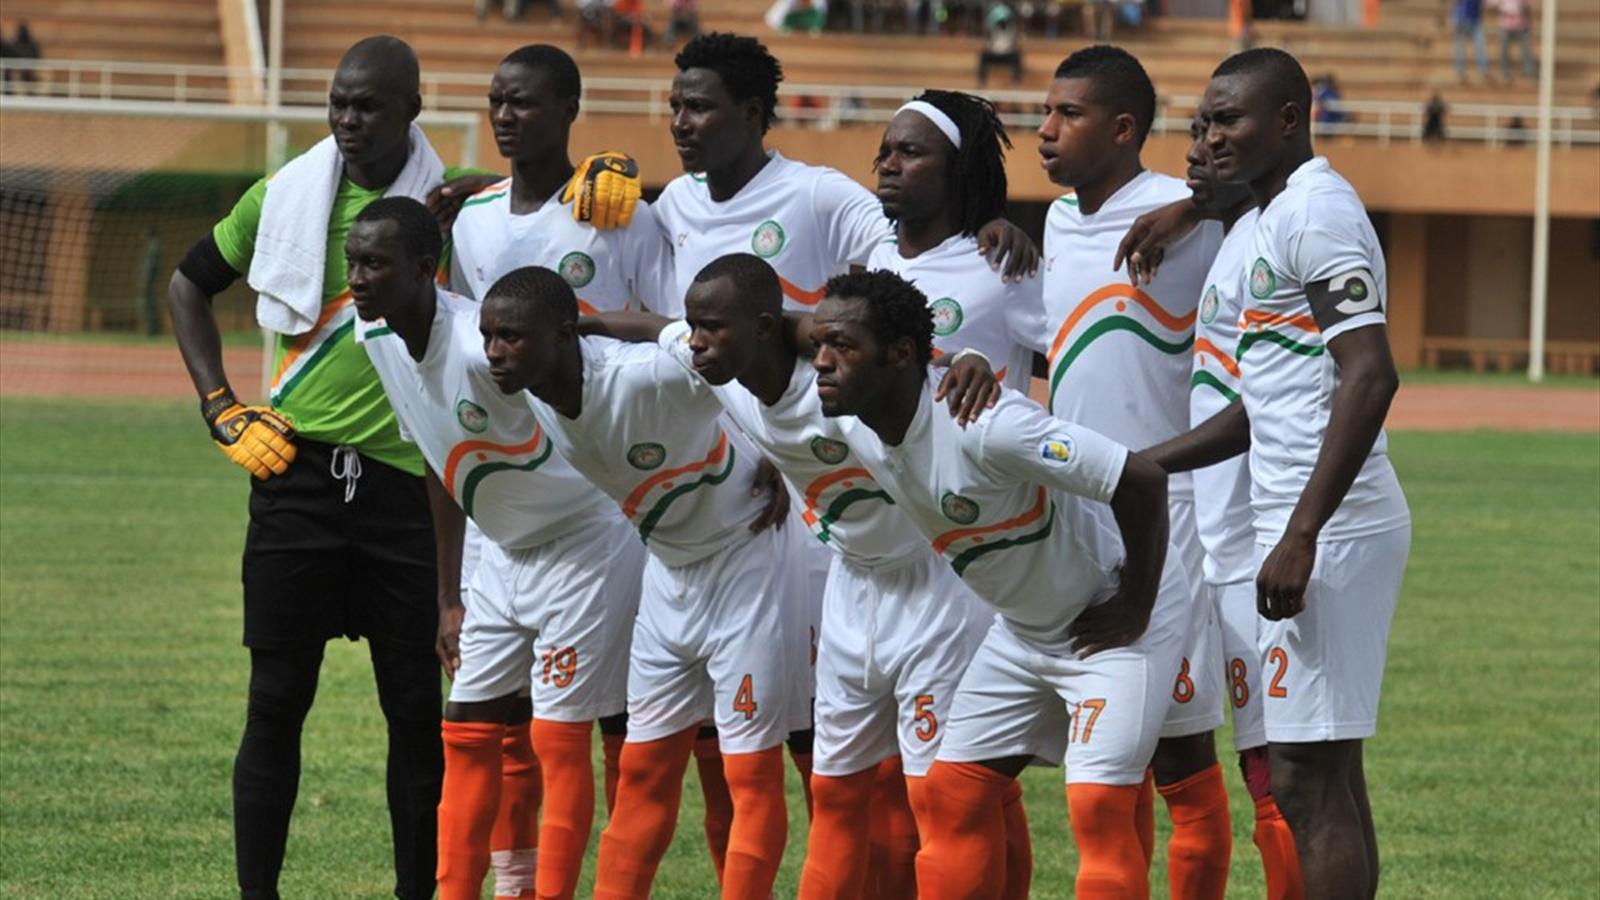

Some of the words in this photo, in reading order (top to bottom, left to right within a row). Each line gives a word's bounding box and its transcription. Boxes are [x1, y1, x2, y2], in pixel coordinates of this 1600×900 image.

[542, 645, 577, 688] 19
[1268, 647, 1288, 698] 2
[733, 673, 757, 720] 4
[914, 694, 937, 742] 5
[1071, 698, 1106, 743] 17
